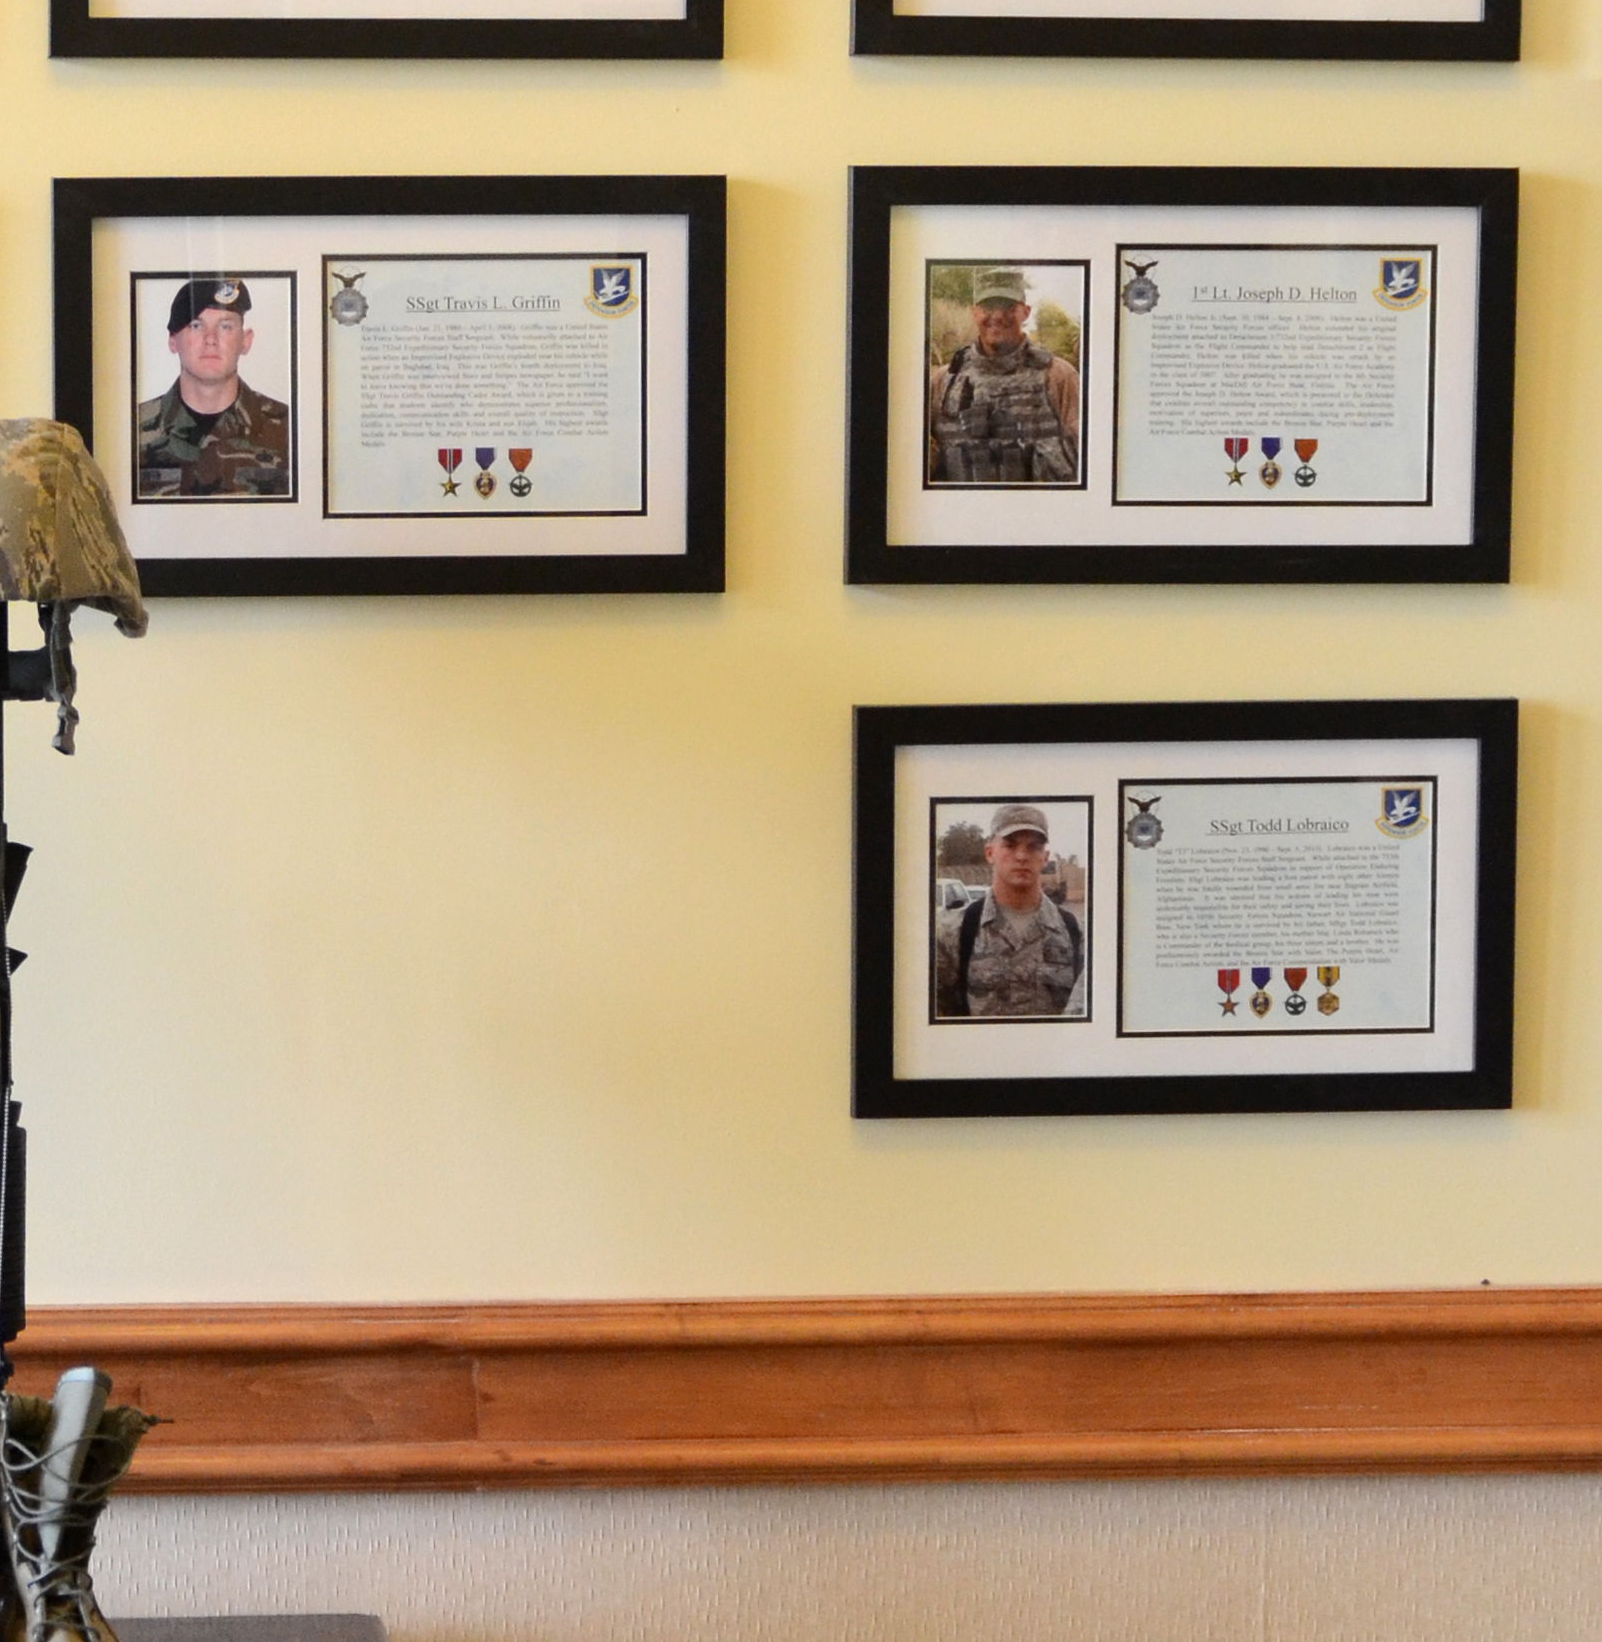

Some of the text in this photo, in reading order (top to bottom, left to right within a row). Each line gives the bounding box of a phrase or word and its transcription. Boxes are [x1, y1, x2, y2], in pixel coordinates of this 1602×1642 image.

[1213, 288, 1230, 300] Lt.
[1237, 287, 1283, 303] Joseph
[1310, 287, 1356, 300] Helton
[406, 297, 440, 313] SSgt
[444, 297, 488, 310] Travis
[513, 296, 560, 309] Griffin
[1211, 819, 1349, 836] SSgt Todd Lobraico
